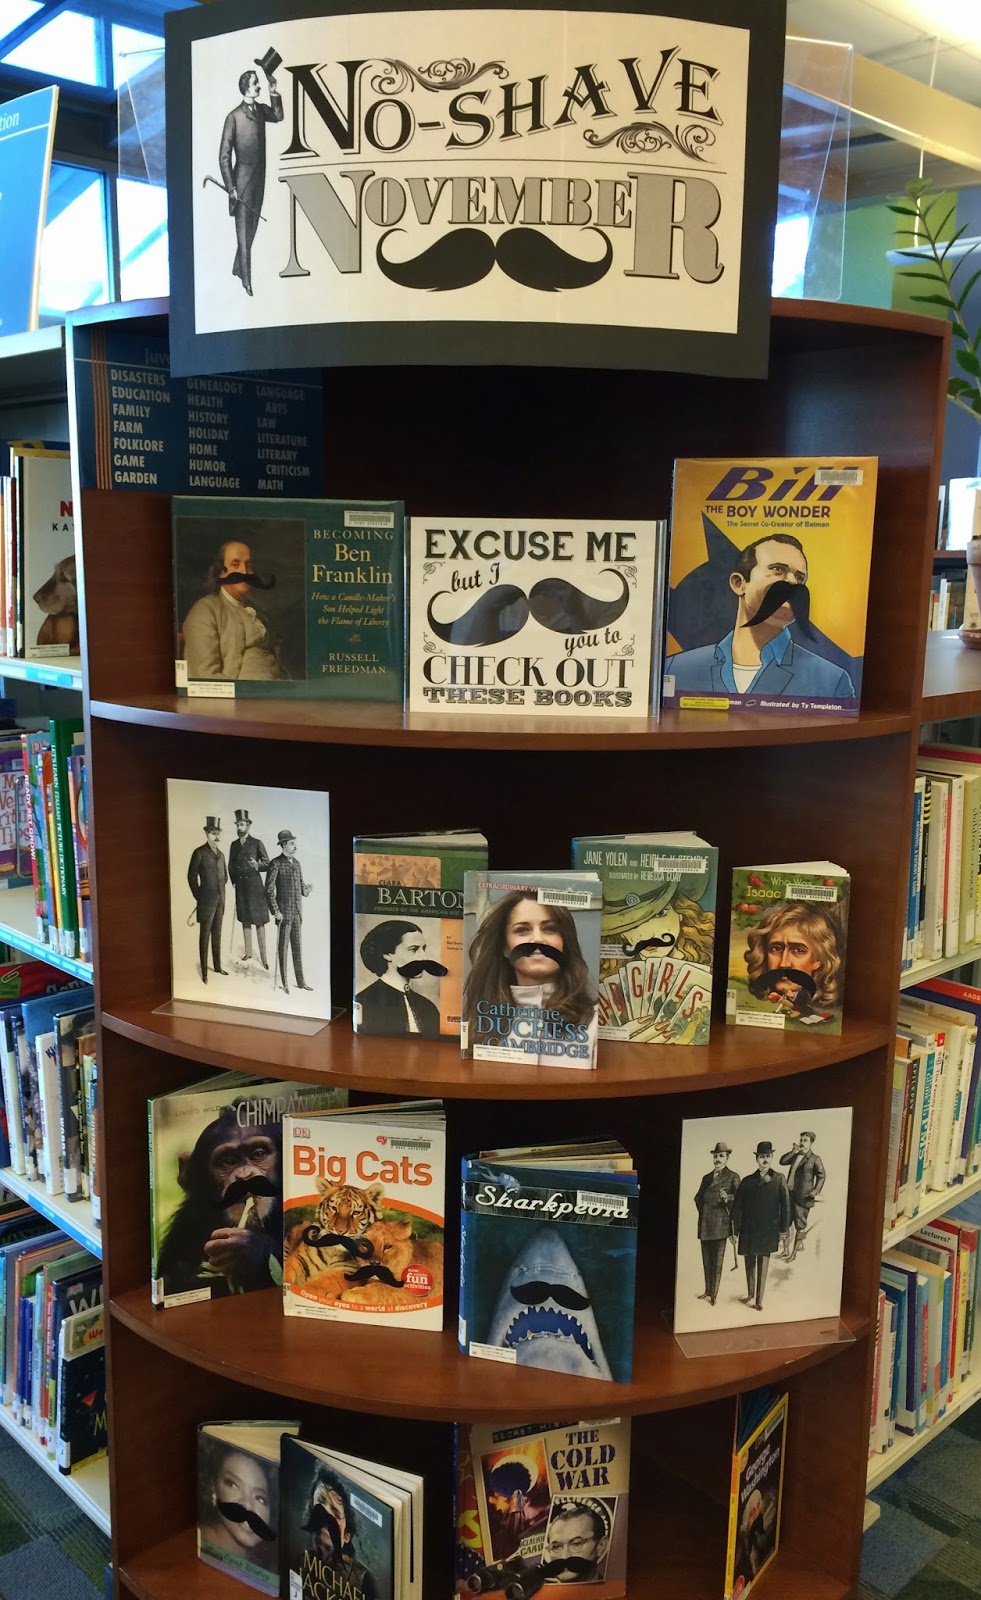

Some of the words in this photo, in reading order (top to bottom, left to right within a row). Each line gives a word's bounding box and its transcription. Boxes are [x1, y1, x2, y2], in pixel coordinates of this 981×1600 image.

[278, 169, 725, 285] NOVEMBER
[111, 368, 166, 386] DISASTERS
[187, 377, 244, 395] GENEALOGY
[256, 386, 305, 401] LANGUAGE
[112, 386, 171, 403] EDUCATION
[187, 393, 224, 409] HEALTH
[112, 403, 151, 418] FAMILY
[265, 402, 288, 415] ARTS
[188, 410, 228, 425] HISTORY
[257, 417, 277, 429] LAW
[113, 420, 143, 434] FARM
[188, 426, 230, 441] HOLIDAY
[113, 437, 164, 452] FOLKLORE
[257, 432, 307, 447] LITERATURE
[189, 443, 218, 456] HOME
[257, 449, 298, 461] LITERARY
[114, 454, 145, 468] GAME
[189, 459, 226, 473] HUMOR
[114, 470, 158, 485] GARDEN
[266, 463, 311, 477] CRITICISM
[189, 475, 240, 489] LANGUAGE
[257, 479, 284, 491] MATH
[705, 505, 723, 514] THE
[726, 505, 758, 518] BOY
[762, 505, 831, 518] WONDER
[726, 520, 738, 528] The
[739, 520, 759, 528] Secret
[760, 520, 794, 528] Co-Creator
[795, 520, 803, 528] of
[313, 529, 394, 541] BECOMING
[335, 543, 371, 562] Ben
[424, 529, 574, 562] EXCUSE
[585, 531, 637, 562] ME
[312, 565, 393, 584] Franklin
[451, 569, 482, 593] but
[489, 562, 500, 584] I
[311, 592, 330, 601] How
[338, 592, 396, 602] Candle-Maker's
[322, 604, 336, 613] Son
[337, 604, 364, 615] Helped
[365, 605, 385, 616] Light
[318, 616, 329, 624] the
[331, 616, 353, 625] Flame
[354, 617, 363, 627] of
[363, 617, 389, 628] Liberty
[564, 634, 600, 657] you
[604, 627, 622, 644] to
[329, 652, 379, 662] RUSSELL
[321, 664, 386, 674] FREEDMAN
[422, 655, 547, 687] CHECK
[556, 657, 634, 689] OUT
[422, 686, 525, 706] THESE
[533, 689, 632, 707] BOOKS
[760, 700, 790, 708] Illustrated
[801, 702, 808, 710] Ty
[810, 703, 842, 711] Templeton
[24, 774, 32, 805] READY
[583, 851, 603, 866] JANE
[605, 852, 628, 867] YOLEN
[640, 870, 665, 882] REBECCA
[770, 876, 791, 886] Who
[478, 881, 529, 892] EXTRAORDINARY
[746, 885, 781, 899] Isaac
[631, 961, 704, 1020] GIRLS
[477, 1016, 589, 1043] DUCHESS
[487, 1037, 590, 1059] CAMBRIDGE
[909, 1063, 918, 1110] EPILEPSY
[293, 1127, 311, 1138] DK
[918, 1117, 929, 1160] PMS
[293, 1145, 347, 1186] Big
[356, 1150, 433, 1187] Cats
[920, 1228, 951, 1244] Lectures?
[406, 1272, 428, 1285] fun
[300, 1290, 318, 1302] Open
[318, 1296, 333, 1305] your
[334, 1301, 350, 1310] eyes
[364, 1304, 385, 1312] world
[387, 1304, 394, 1312] of
[394, 1301, 428, 1312] discovery
[493, 1426, 534, 1441] SECRET
[565, 1429, 600, 1446] THE
[551, 1444, 616, 1471] COLD
[745, 1444, 771, 1481] George
[555, 1466, 610, 1492] WAR
[741, 1447, 780, 1504] Washington
